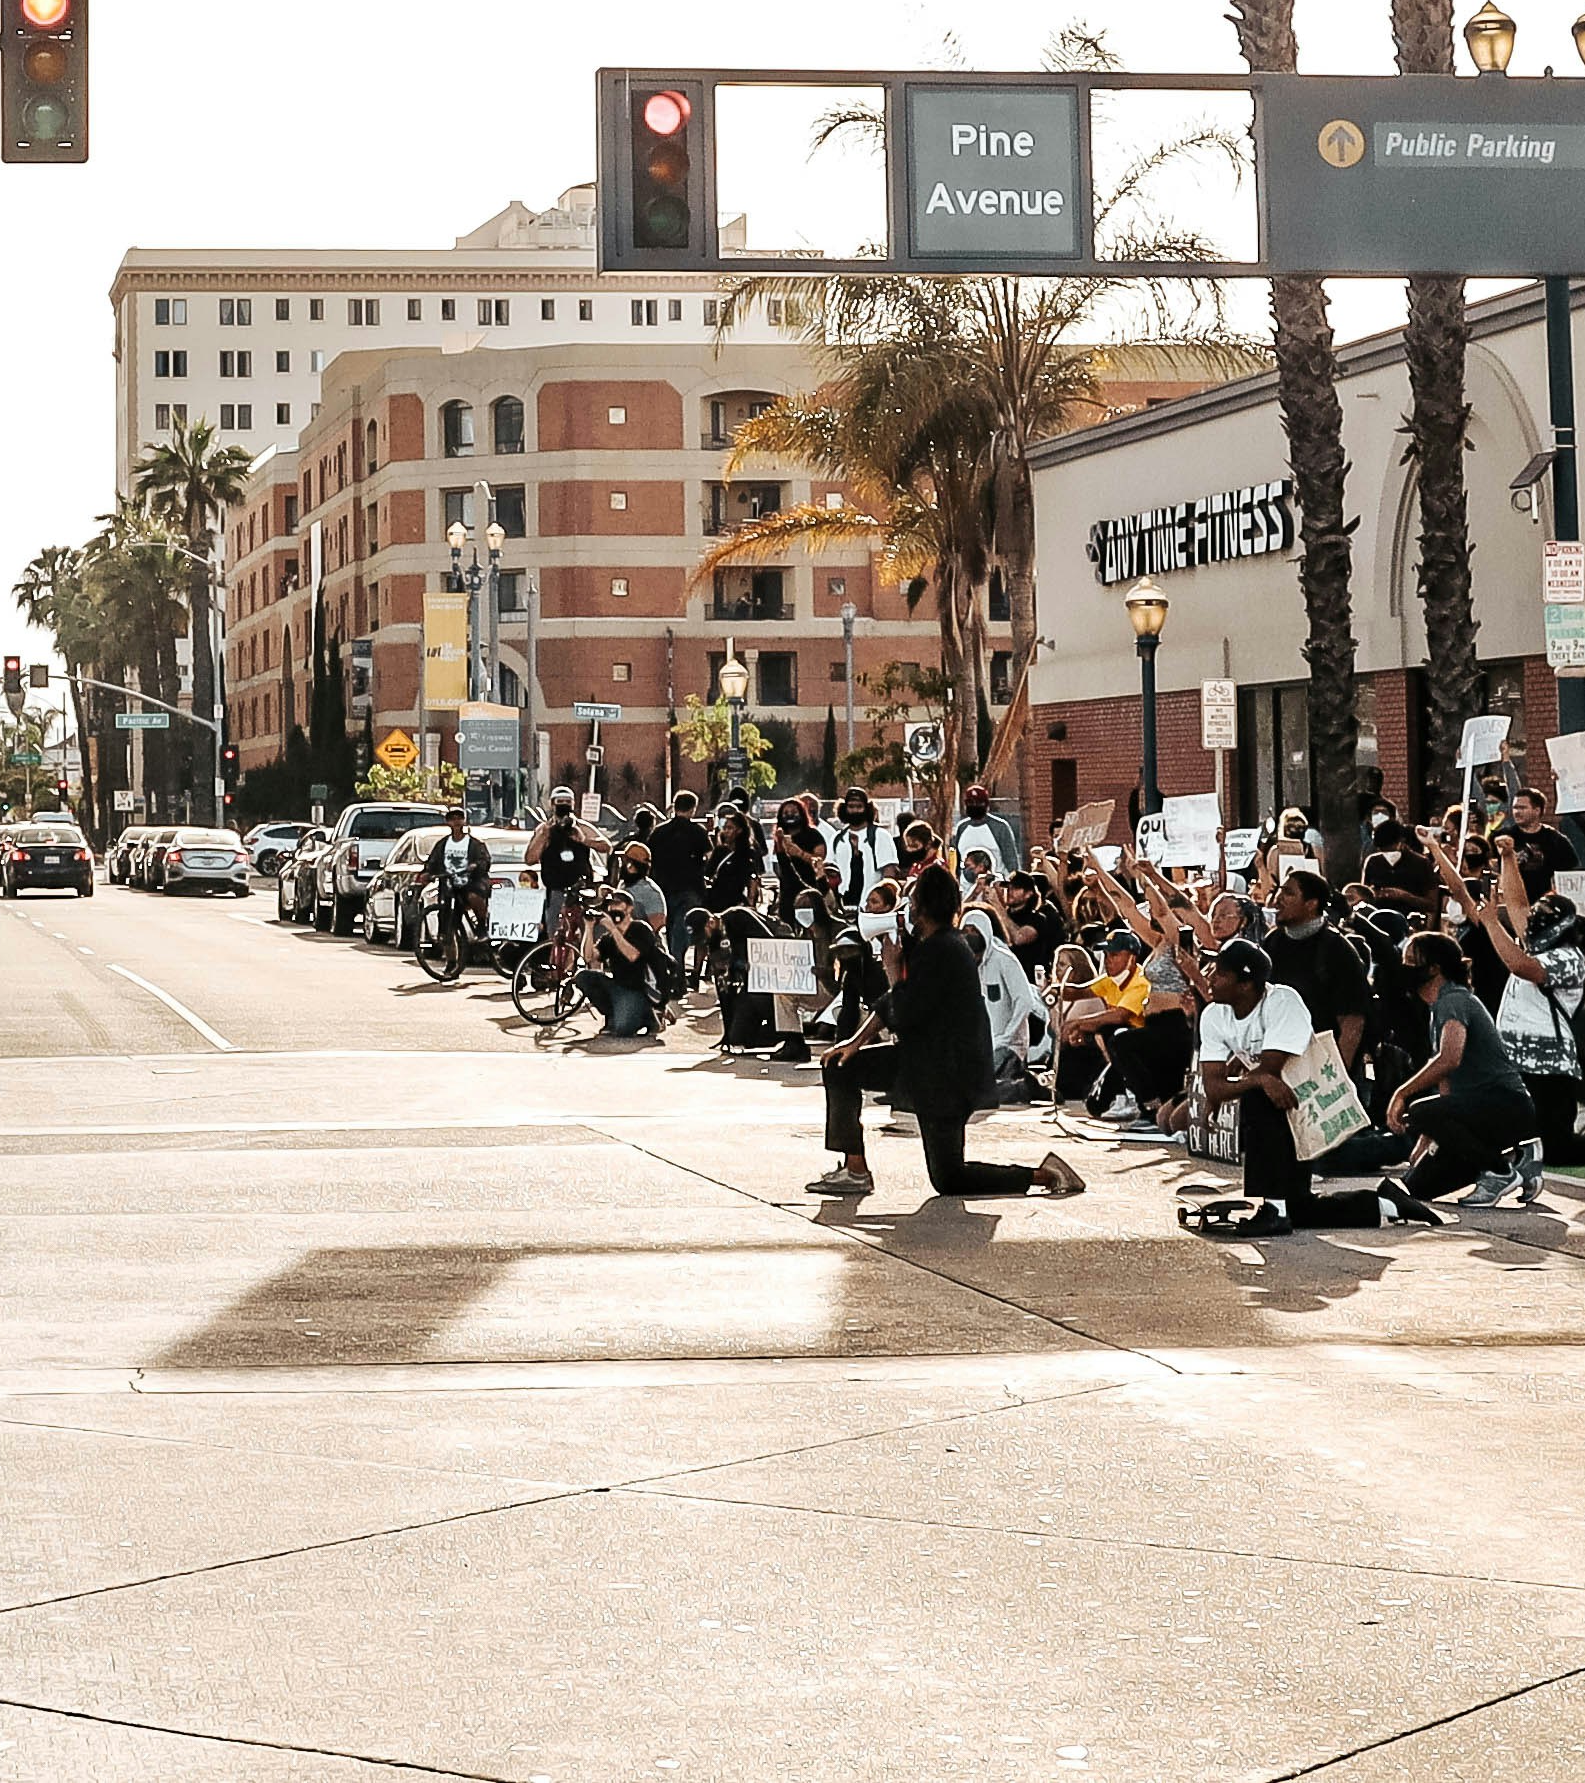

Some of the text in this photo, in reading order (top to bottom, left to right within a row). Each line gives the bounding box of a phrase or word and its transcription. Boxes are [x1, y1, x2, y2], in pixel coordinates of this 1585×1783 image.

[951, 123, 1034, 157] Pine
[1385, 132, 1556, 164] Public Parking
[925, 182, 1064, 216] Avenue
[1105, 478, 1284, 583] ANYTIME FITNESS
[1551, 639, 1557, 651] 9
[1573, 638, 1579, 650] 9
[1558, 875, 1579, 892] HOW
[1189, 1123, 1239, 1163] BE HERE!
